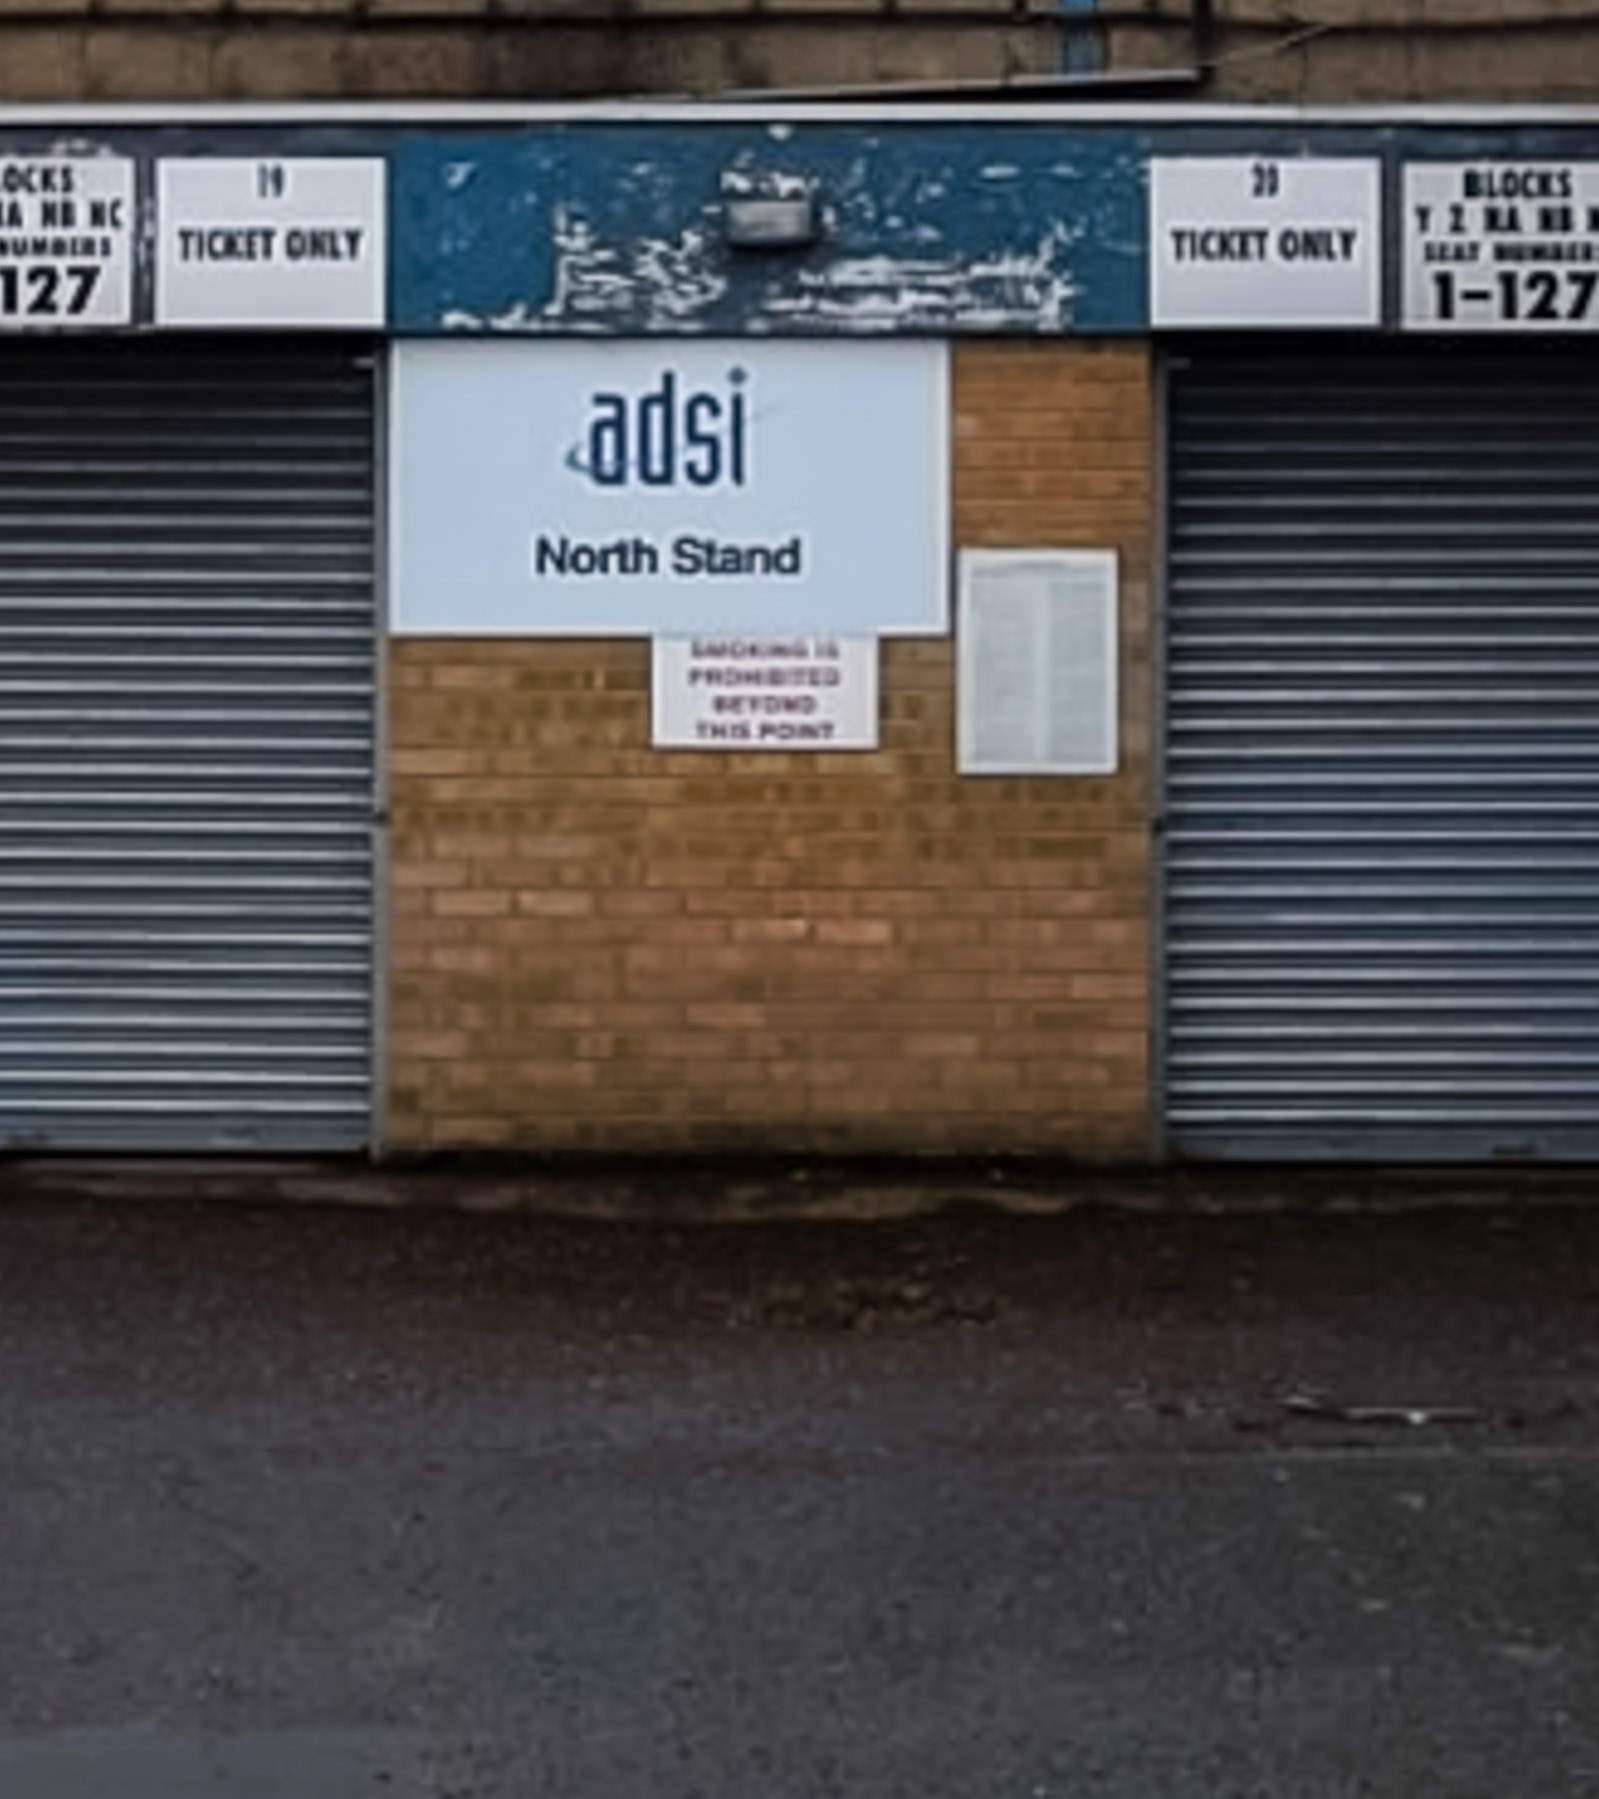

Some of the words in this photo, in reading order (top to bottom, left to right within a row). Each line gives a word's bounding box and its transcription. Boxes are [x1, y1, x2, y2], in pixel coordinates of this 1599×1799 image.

[1463, 168, 1573, 198] BLOCKS
[1415, 204, 1432, 234] Y
[177, 226, 277, 262] TICKET
[284, 226, 364, 262] ONLY
[1170, 227, 1269, 262] TICKET
[1277, 227, 1358, 262] ONLY
[590, 365, 748, 487] adsi
[534, 533, 659, 576] North
[670, 533, 802, 577] Stand
[712, 695, 818, 715] BEYOND
[695, 721, 751, 740] THIS
[759, 721, 836, 740] POINT
